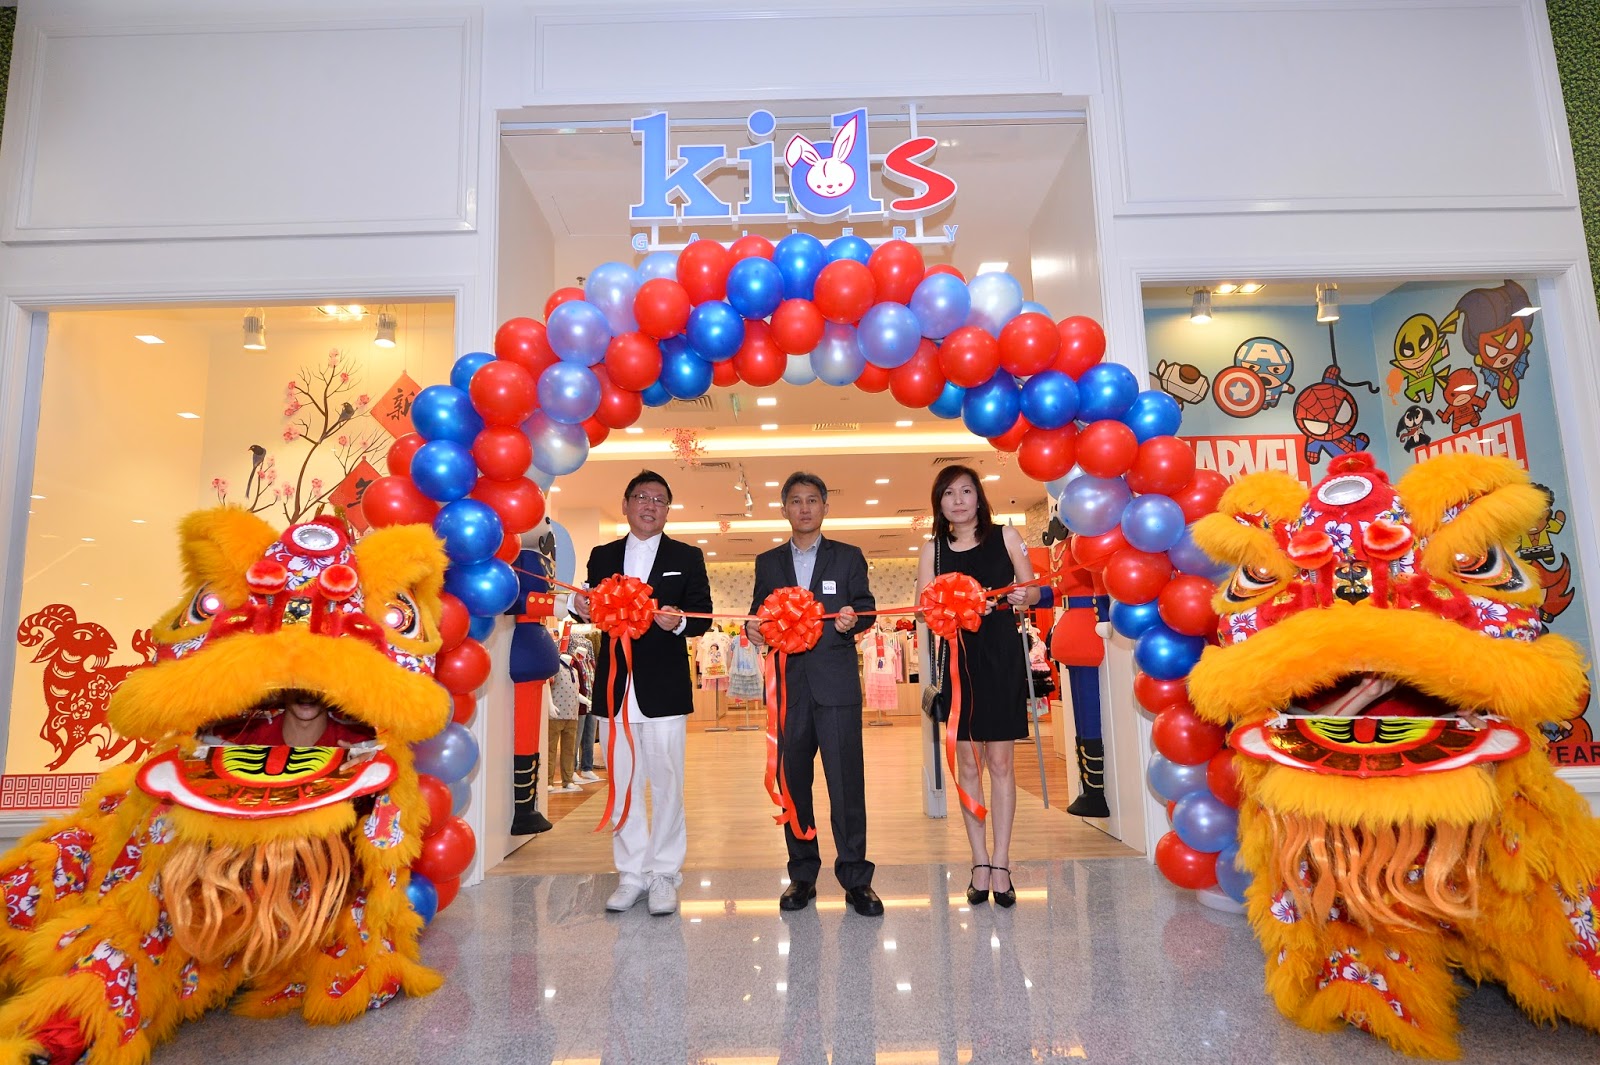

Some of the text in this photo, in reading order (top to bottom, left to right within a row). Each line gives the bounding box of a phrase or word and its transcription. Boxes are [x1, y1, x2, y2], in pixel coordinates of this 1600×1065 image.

[629, 107, 957, 217] kids
[1184, 438, 1309, 490] ARVEL
[1547, 745, 1600, 764] EAR
